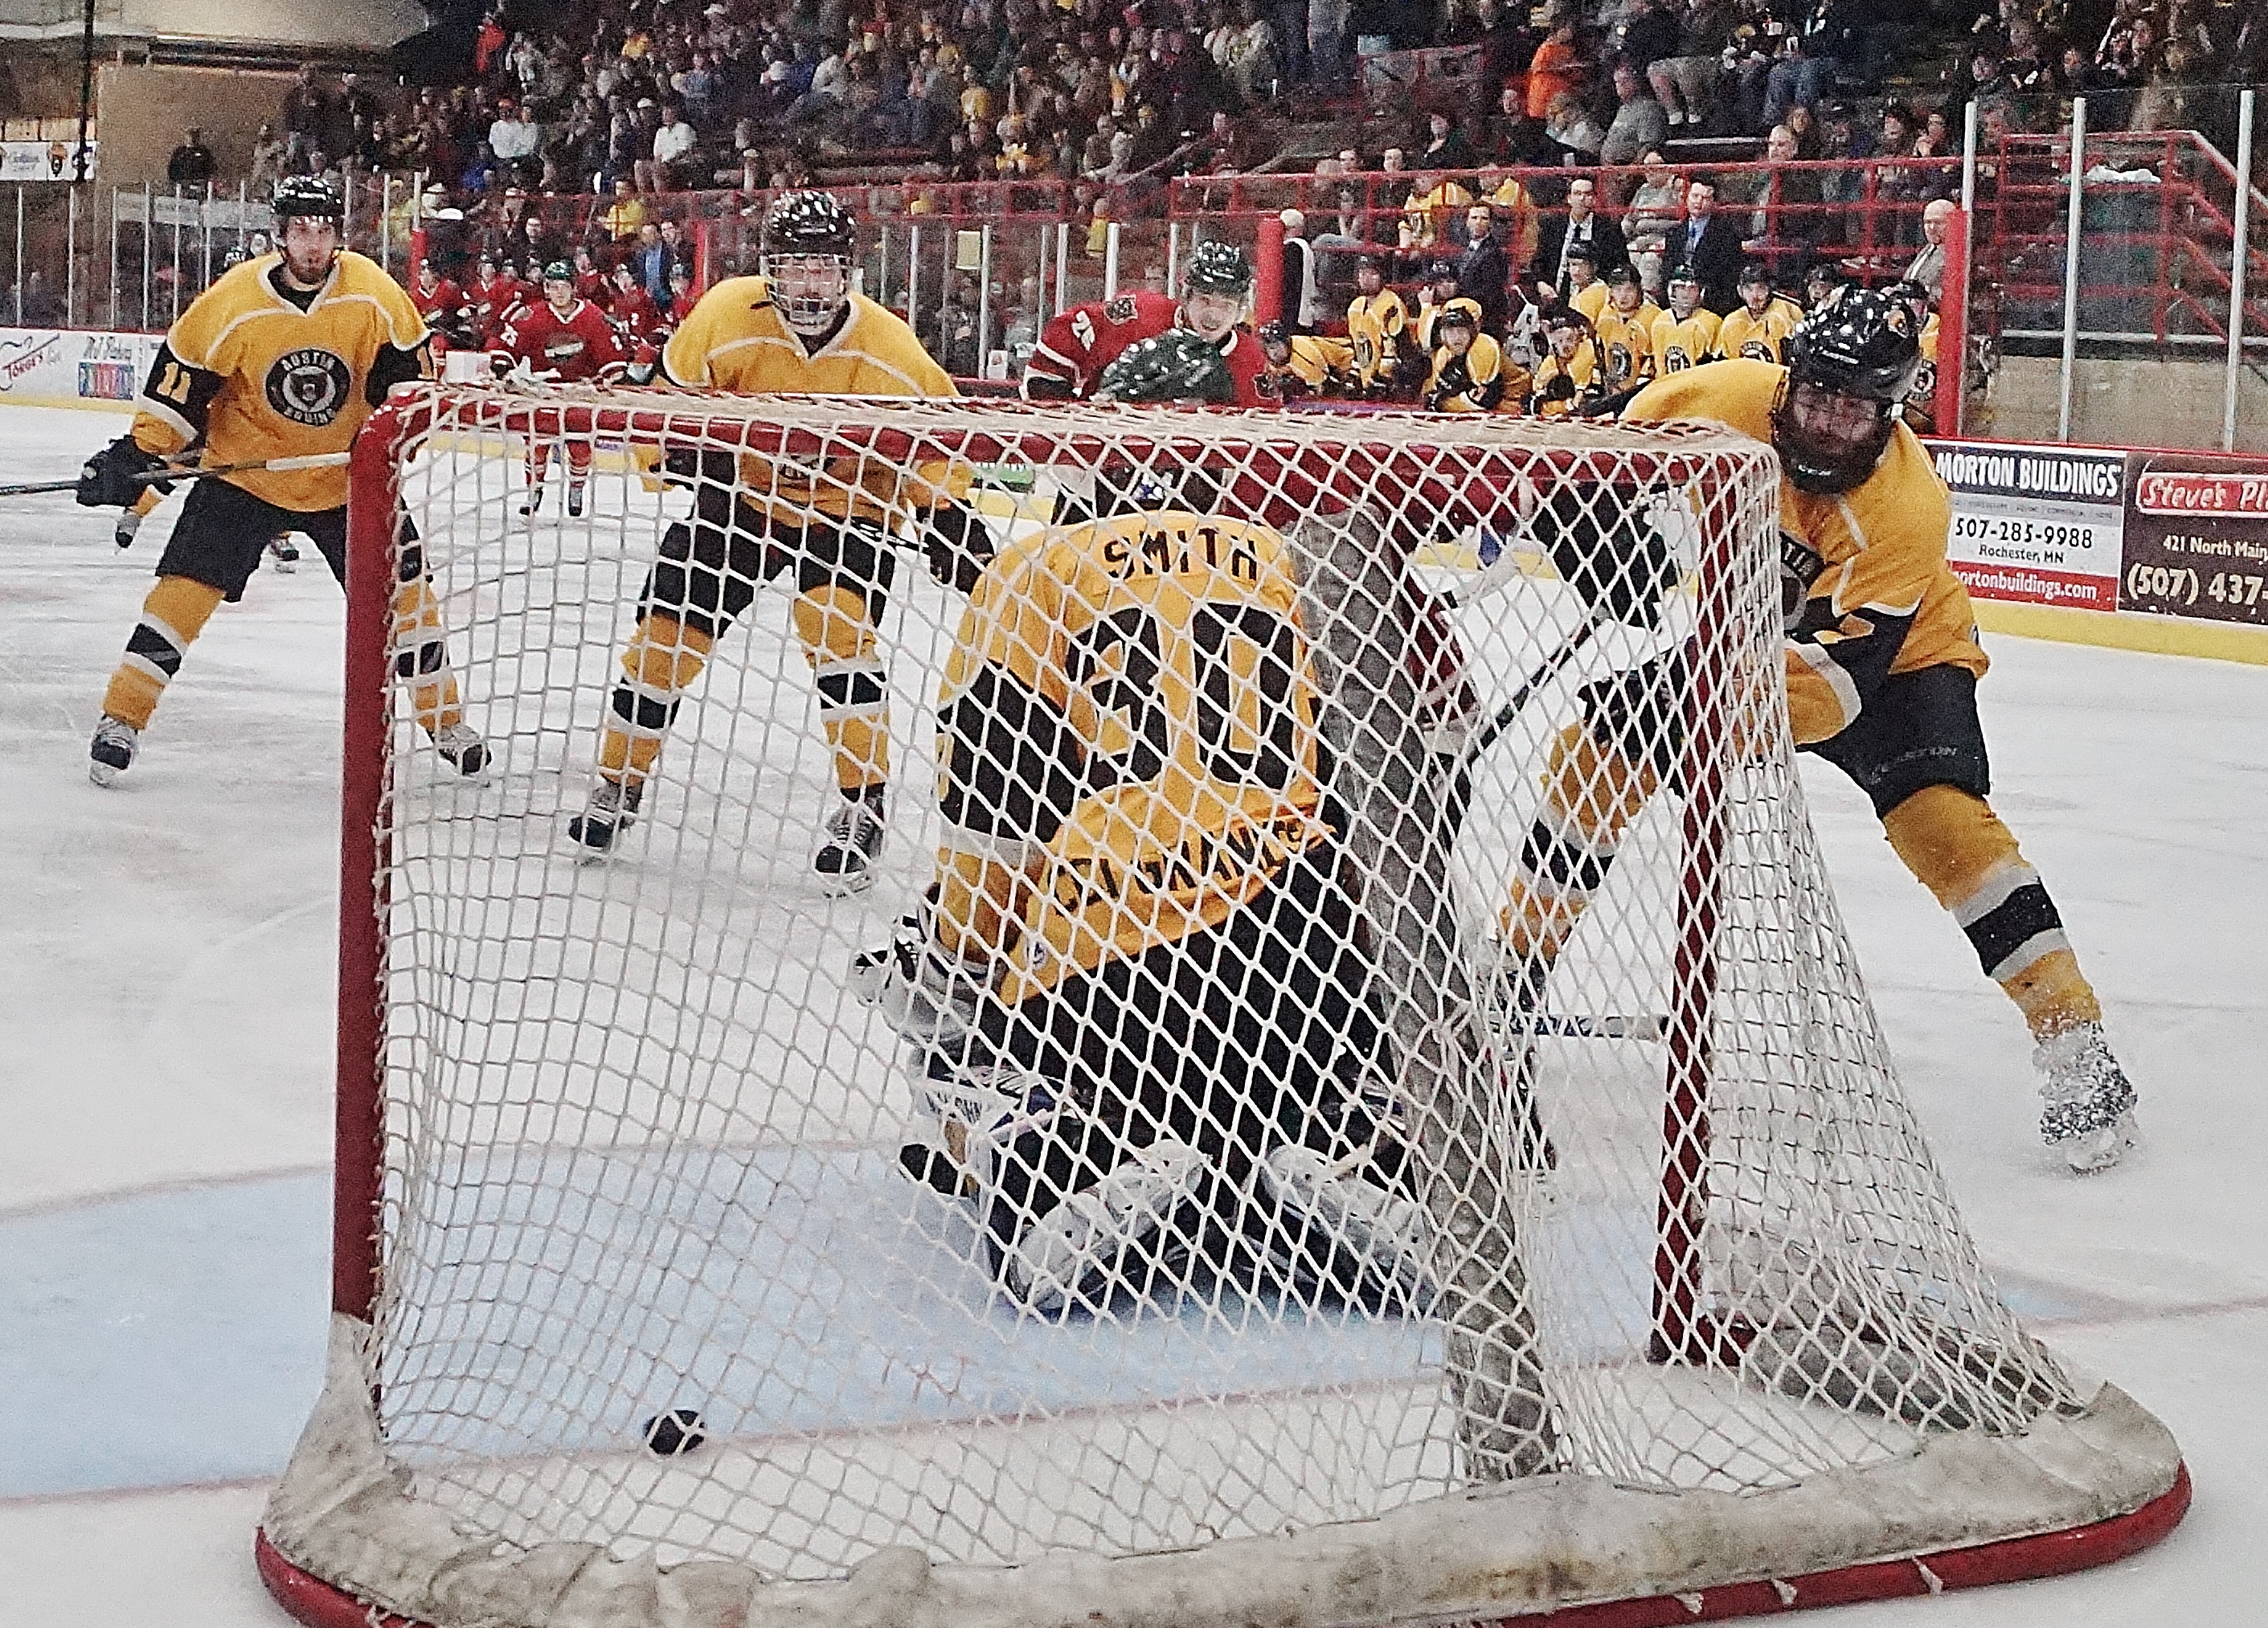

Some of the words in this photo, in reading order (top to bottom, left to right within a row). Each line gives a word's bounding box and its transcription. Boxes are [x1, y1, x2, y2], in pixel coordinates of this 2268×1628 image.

[1936, 452, 2015, 487] MORTON
[2018, 457, 2119, 497] BUILDINGS
[2240, 482, 2268, 511] Pl
[1955, 517, 2093, 549] 507-285-9988
[2163, 534, 2185, 552] 421
[2190, 537, 2231, 556] North
[1104, 527, 1258, 579] SMITH
[2044, 550, 2064, 563] MN
[2127, 562, 2199, 605] (507)
[1065, 603, 1296, 796] 30
